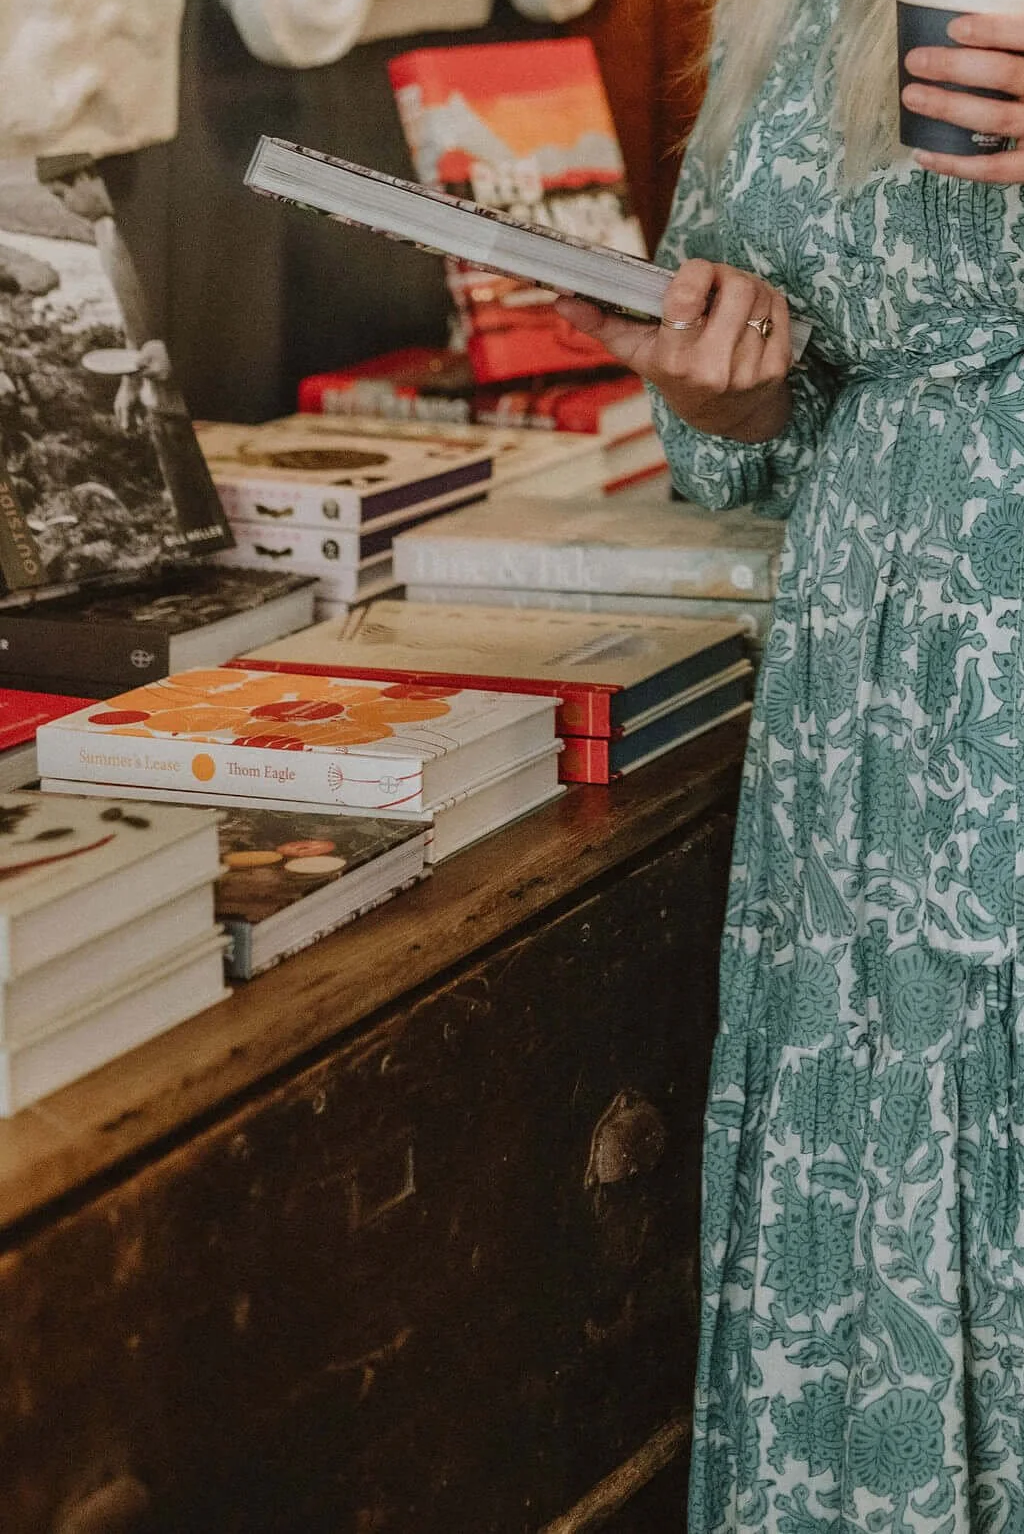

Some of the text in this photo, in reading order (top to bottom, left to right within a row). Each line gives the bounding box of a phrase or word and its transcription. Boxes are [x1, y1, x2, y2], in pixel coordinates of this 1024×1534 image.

[79, 747, 296, 783] Summer's Lease Thom Eagle
